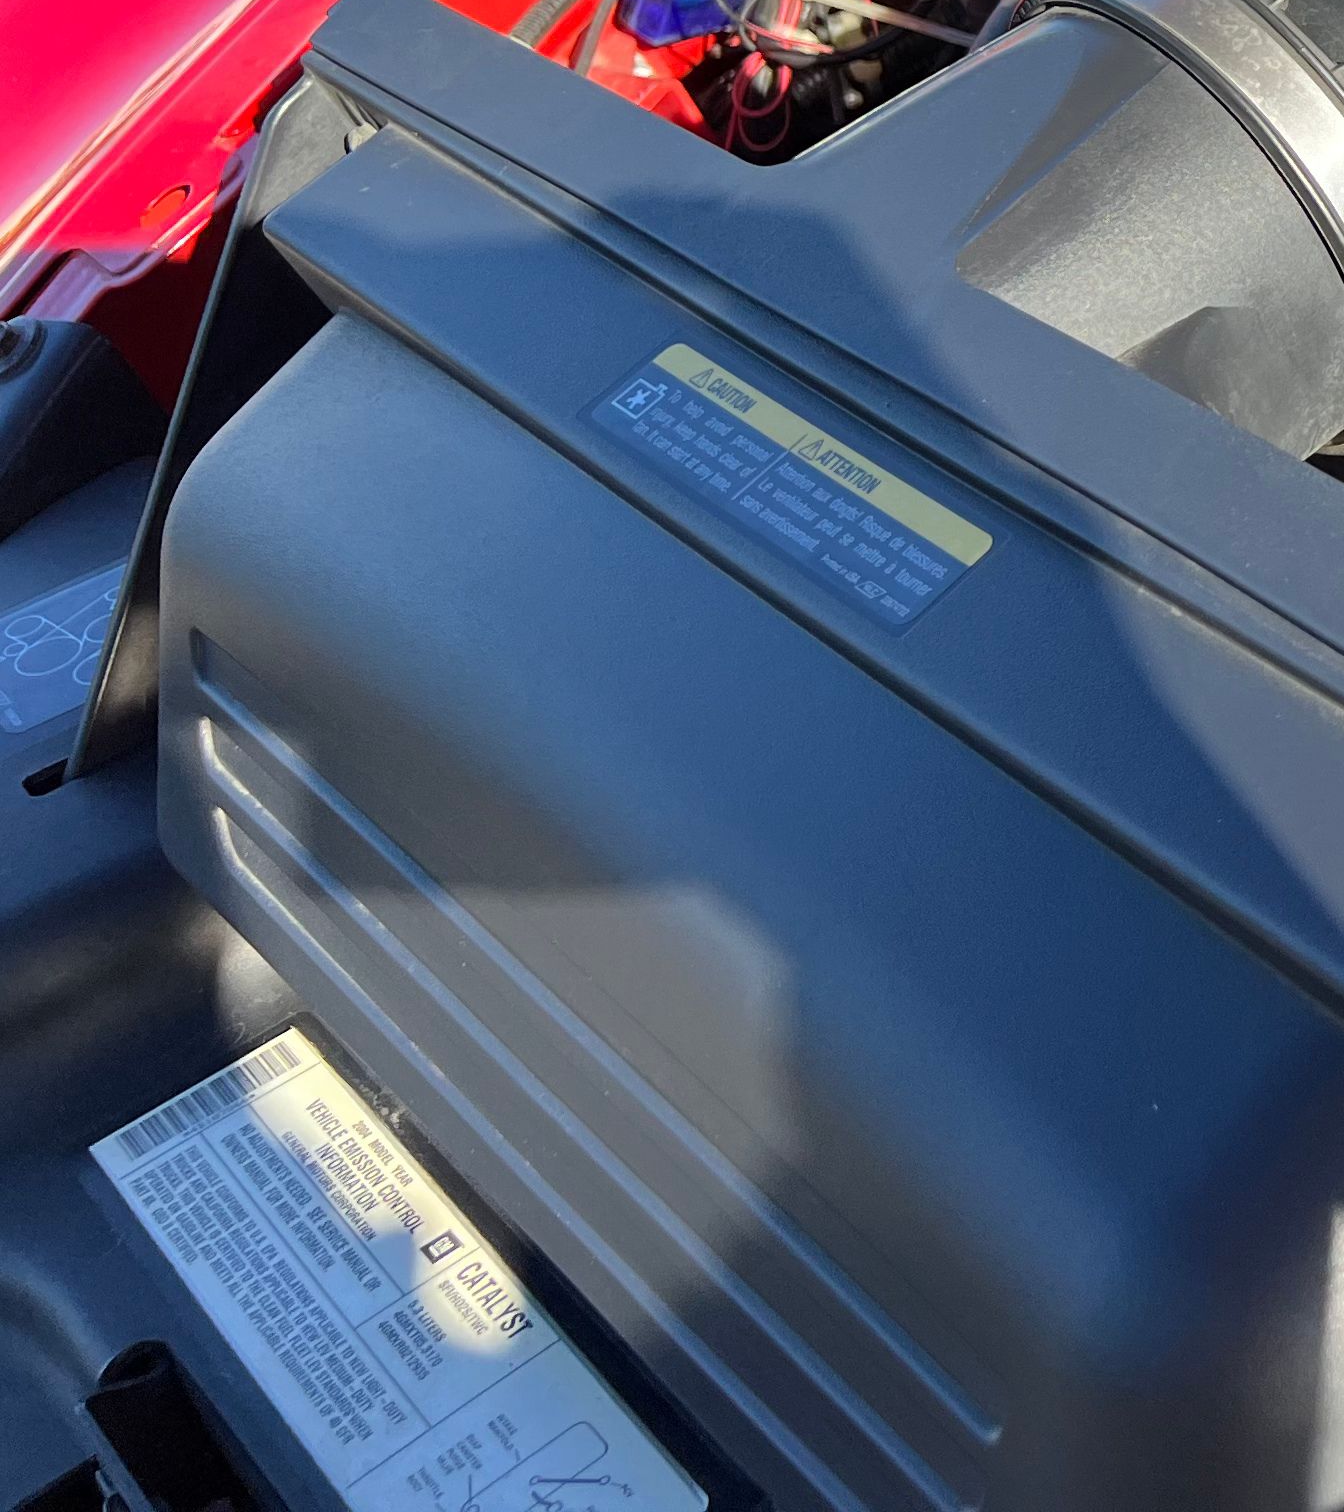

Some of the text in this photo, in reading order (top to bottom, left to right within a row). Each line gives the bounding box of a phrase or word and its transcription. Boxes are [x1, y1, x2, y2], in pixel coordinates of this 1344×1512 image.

[678, 399, 708, 421] help
[704, 376, 758, 414] CAUTION
[650, 434, 673, 452] can
[664, 442, 693, 464] start
[689, 462, 715, 482] any
[814, 447, 883, 495] ATTENTION
[736, 493, 765, 514] sans
[754, 477, 776, 494] Le
[811, 515, 844, 540] peut
[836, 532, 857, 548] se
[892, 567, 935, 598] tourner
[218, 1131, 252, 1165] OWNERS
[245, 1131, 293, 1182] ADJUSTMENTS
[350, 1119, 414, 1188] 2004 MODEL YEAR
[240, 1158, 274, 1191] MANUAL
[303, 1097, 427, 1235] VEHICLE EMISSION CONTROL
[313, 1141, 380, 1213] INFORMATION
[261, 1185, 285, 1206] FOR
[280, 1129, 378, 1242] GENERAL MOTORS CORPORATION
[272, 1199, 300, 1225] MORE
[305, 1205, 329, 1226] SEE
[315, 1218, 351, 1253] SERVICE
[237, 1268, 256, 1284] TO
[338, 1247, 374, 1282] MANUAL
[239, 1218, 258, 1233] TO
[338, 1344, 357, 1360] TO
[453, 1260, 535, 1341] CATALYST
[290, 1311, 309, 1326] TO
[416, 1311, 449, 1343] LITERS
